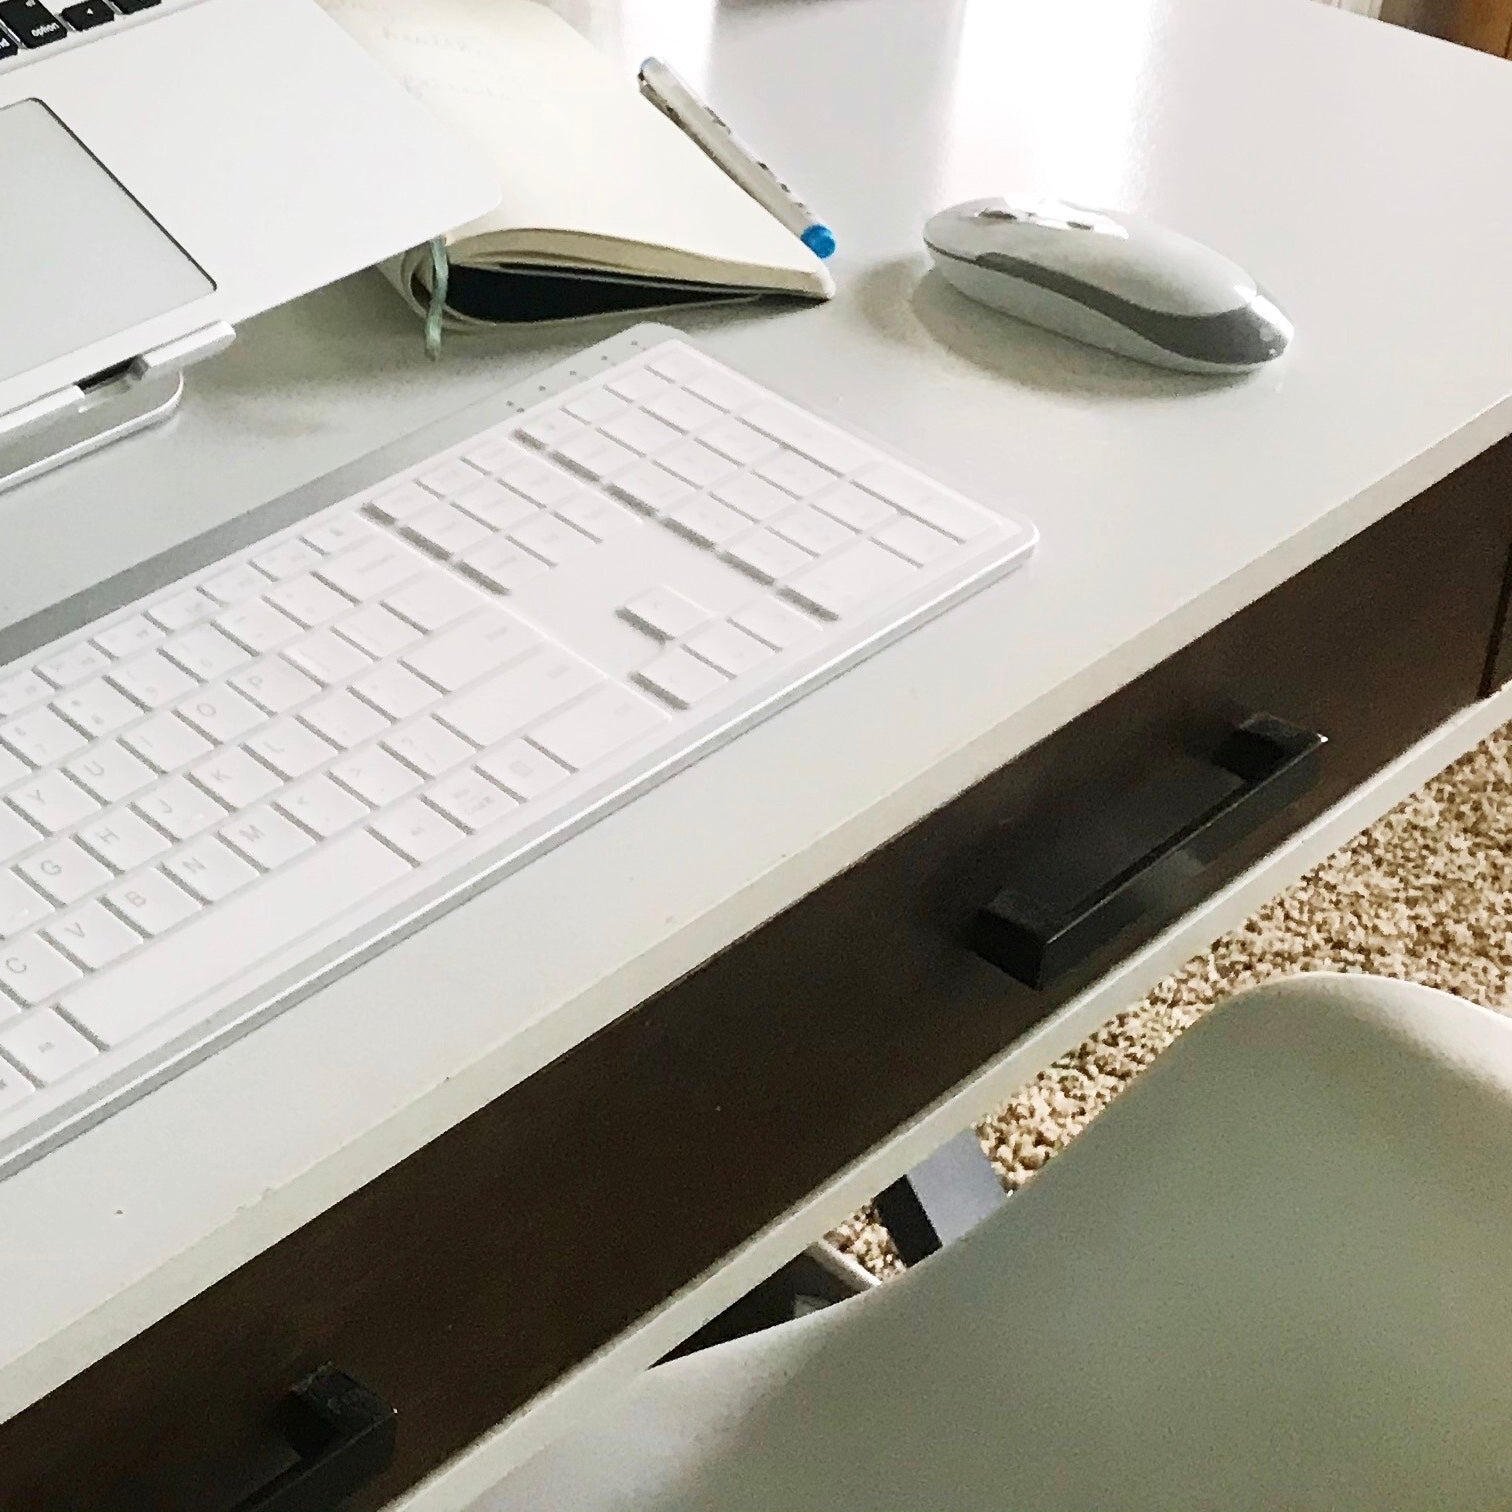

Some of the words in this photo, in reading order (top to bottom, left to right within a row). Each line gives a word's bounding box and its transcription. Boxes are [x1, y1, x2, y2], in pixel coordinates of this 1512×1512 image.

[31, 22, 60, 37] option
[40, 860, 62, 875] G
[6, 957, 27, 973] C
